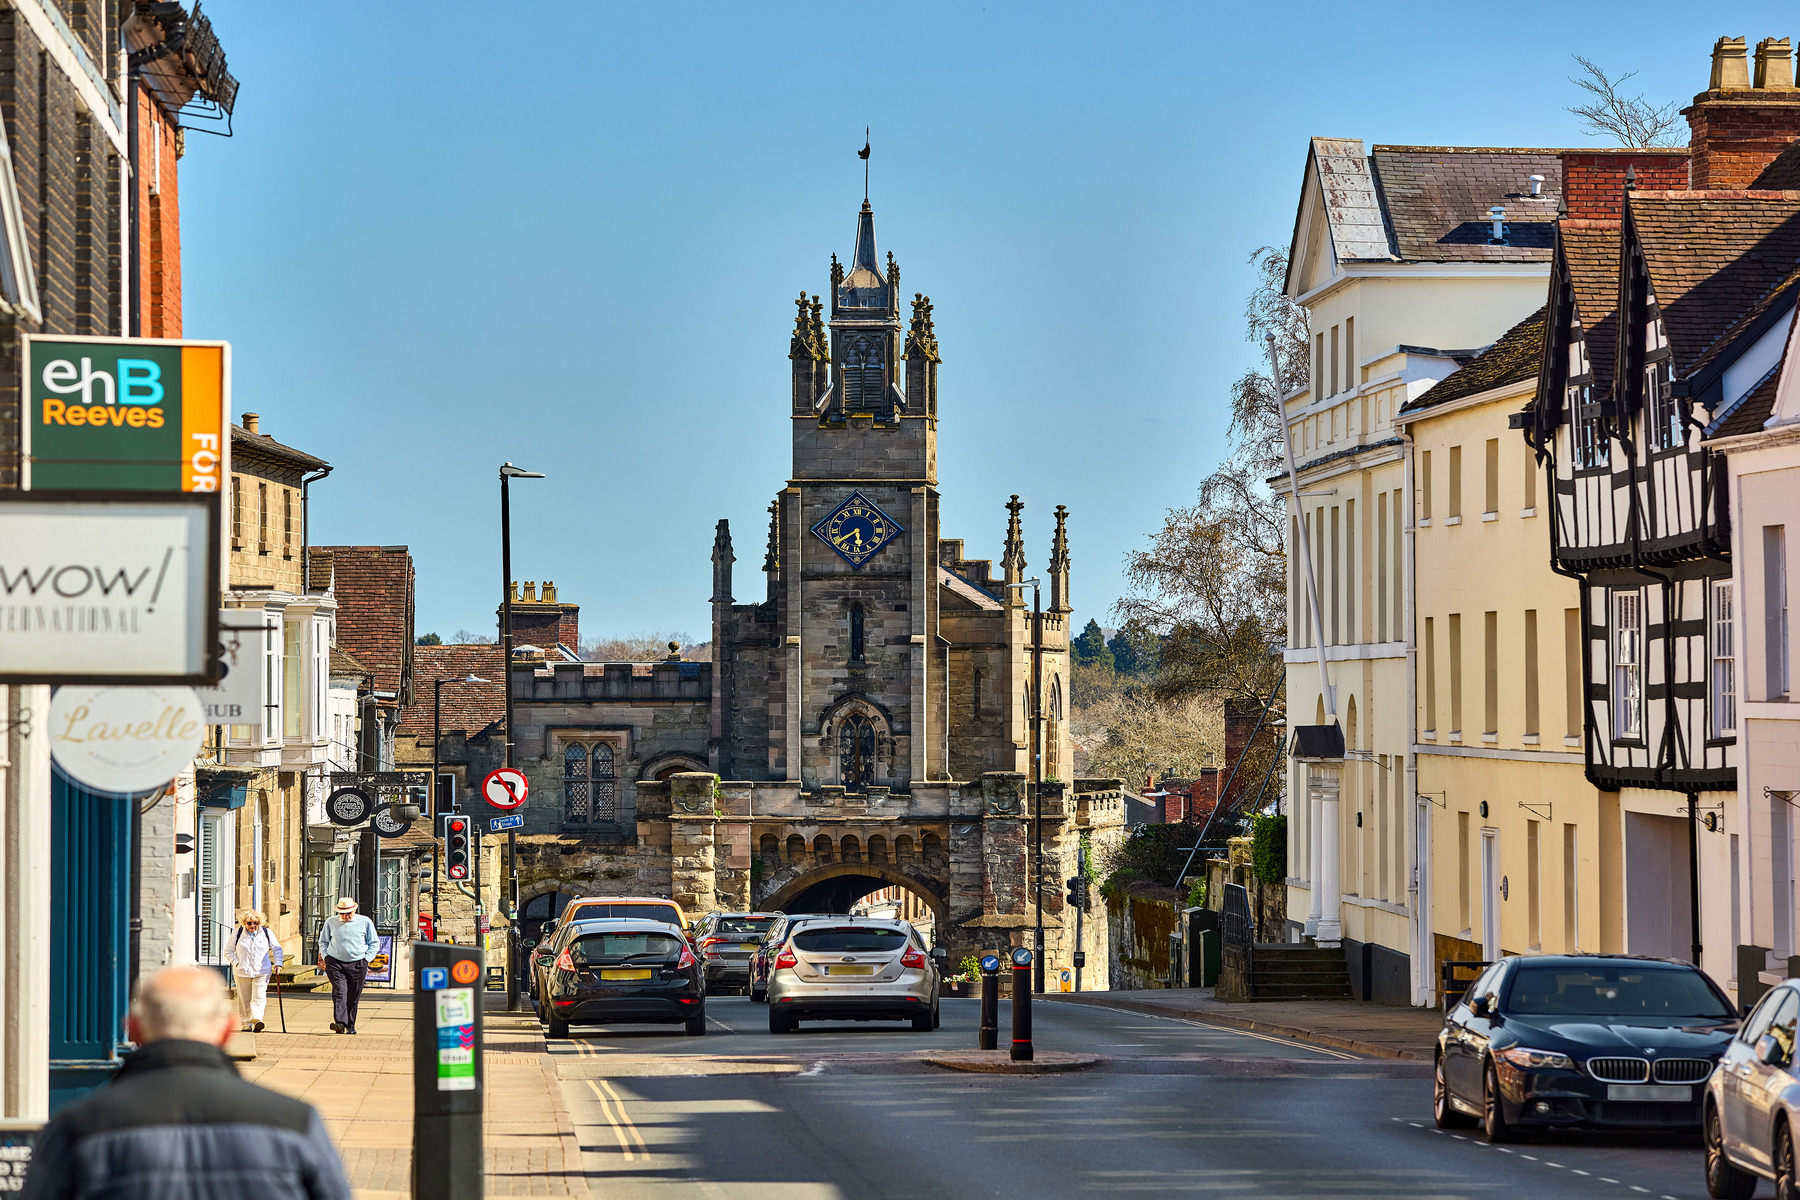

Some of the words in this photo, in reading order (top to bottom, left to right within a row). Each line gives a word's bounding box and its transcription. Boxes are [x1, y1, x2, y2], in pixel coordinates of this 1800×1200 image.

[42, 356, 165, 405] ehB
[42, 398, 165, 428] Reeves
[191, 433, 218, 492] FOR
[52, 705, 199, 743] Lavelle
[428, 971, 444, 988] P
